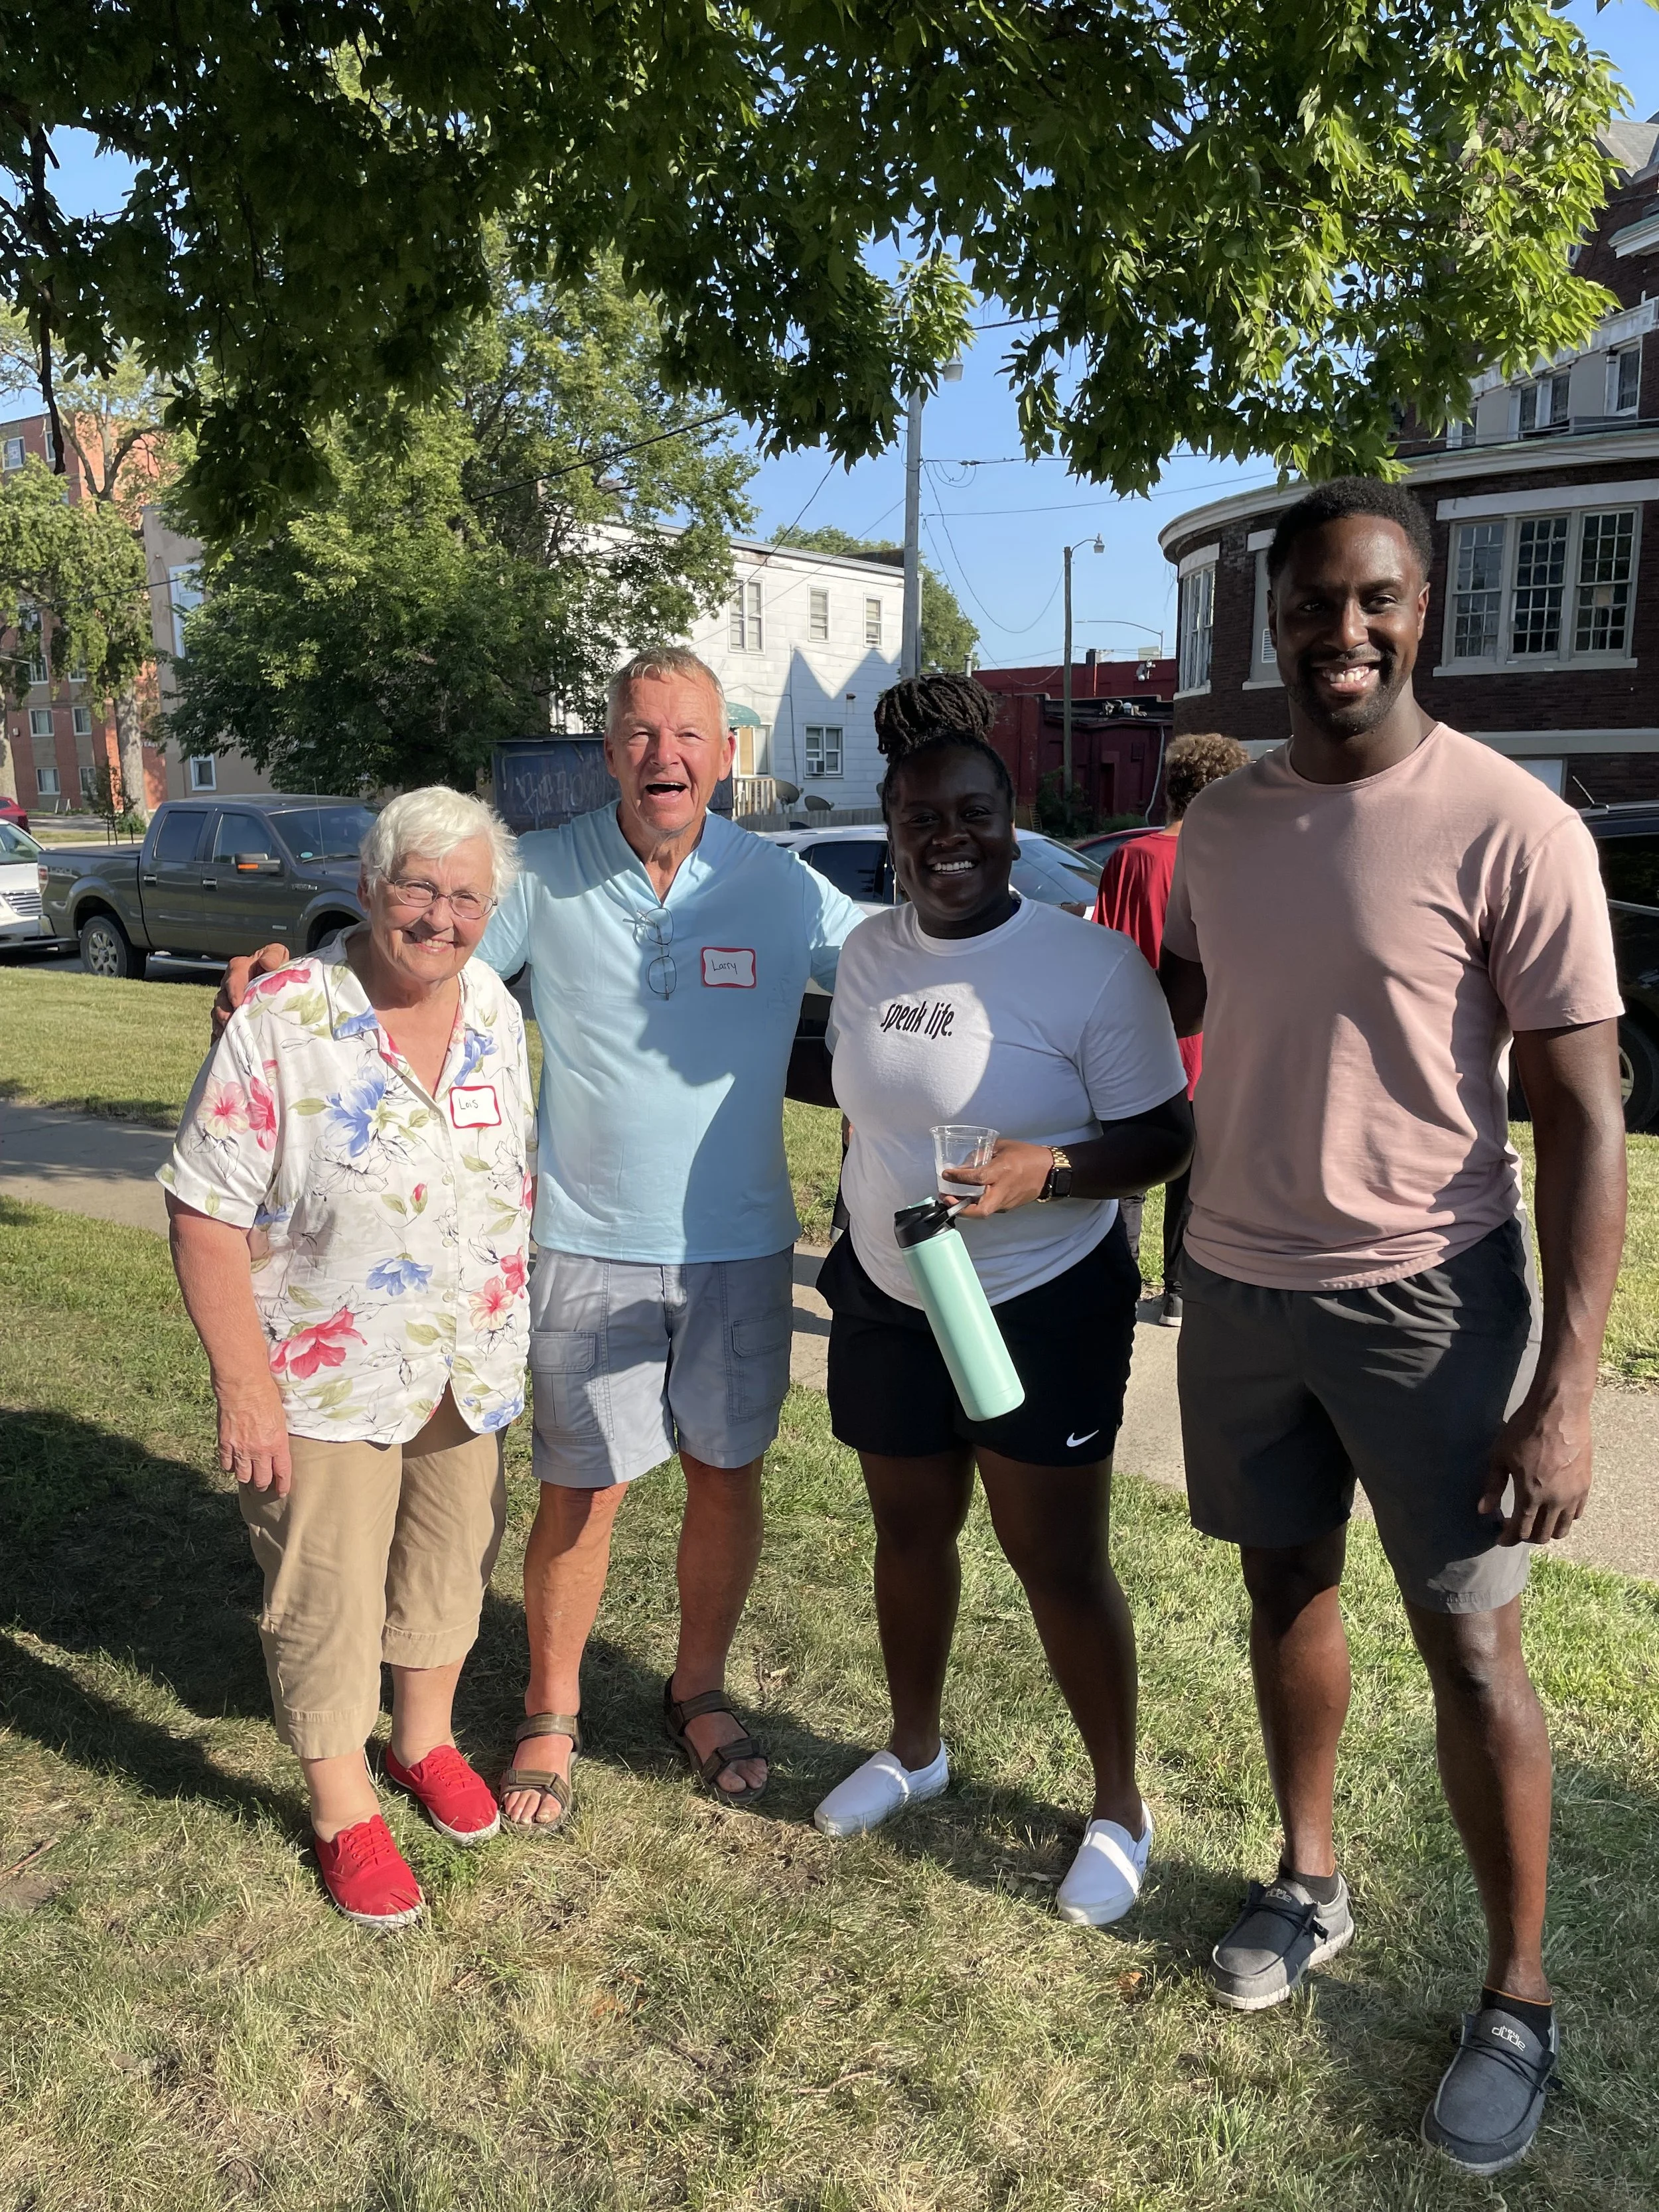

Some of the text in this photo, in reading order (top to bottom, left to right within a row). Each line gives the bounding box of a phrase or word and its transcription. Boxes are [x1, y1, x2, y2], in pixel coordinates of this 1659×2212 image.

[711, 959, 738, 975] Larry
[881, 1001, 927, 1033] speak
[459, 1097, 478, 1110] Lois
[1492, 2026, 1526, 2051] dude
